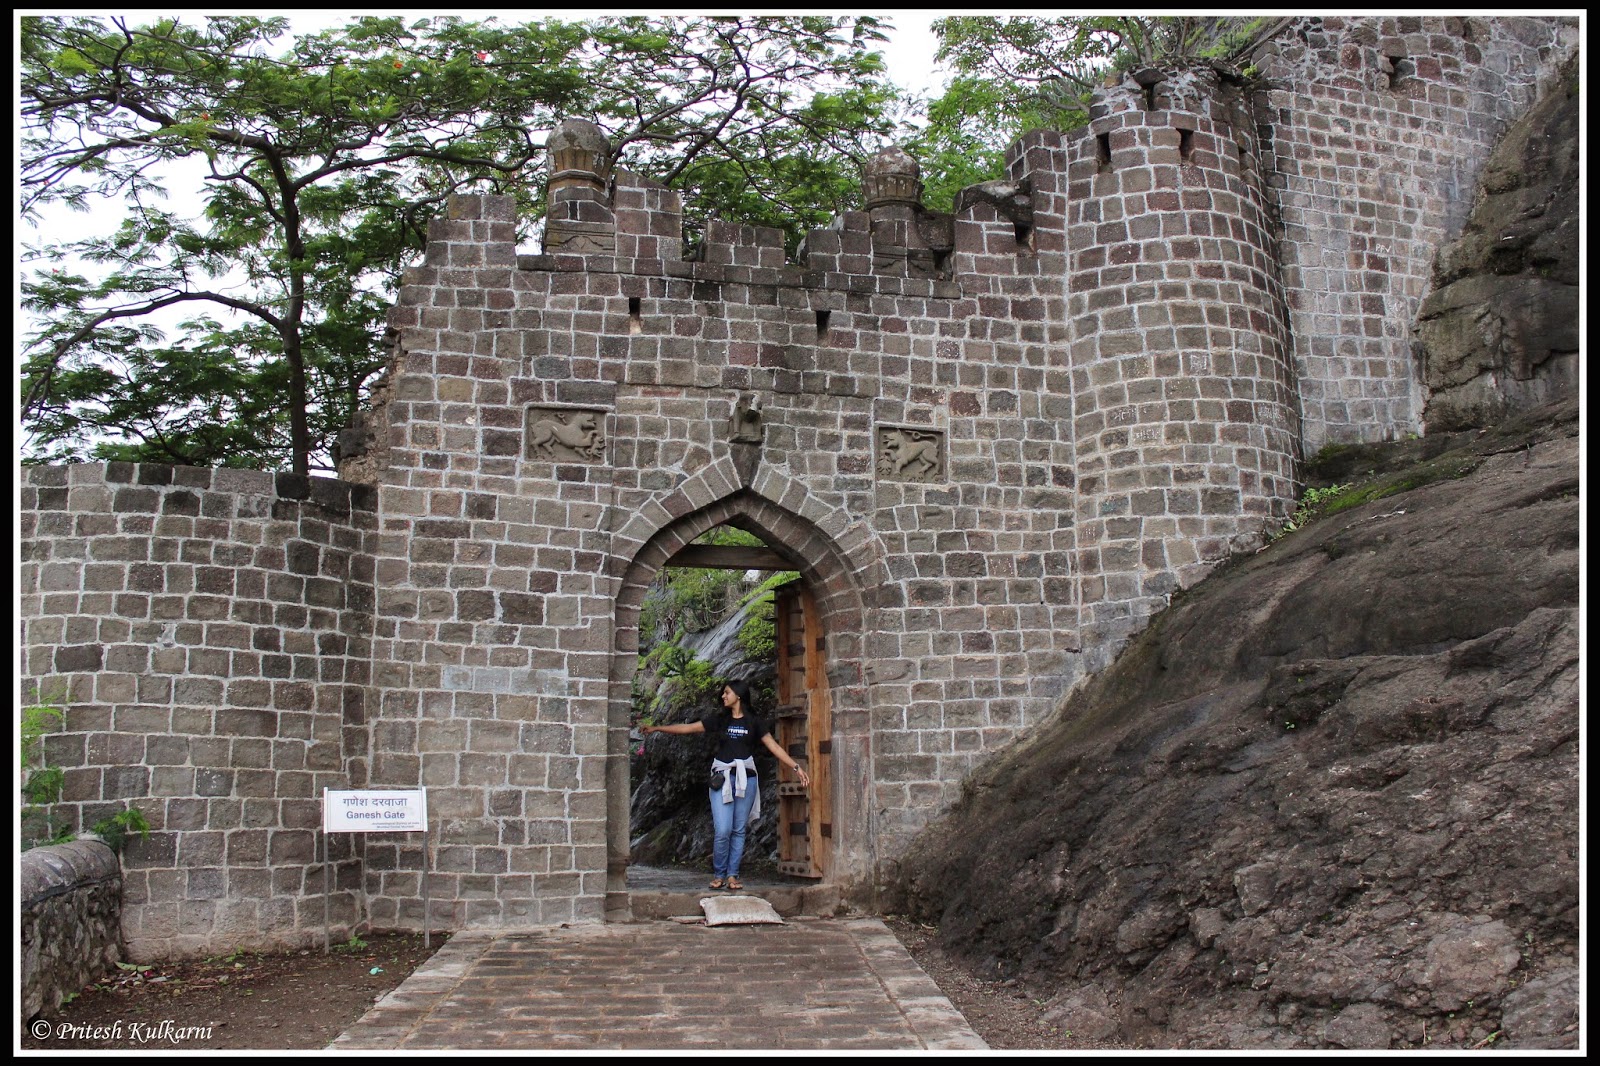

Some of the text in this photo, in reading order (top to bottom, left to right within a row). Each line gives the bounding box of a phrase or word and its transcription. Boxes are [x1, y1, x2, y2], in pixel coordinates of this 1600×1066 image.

[342, 795, 408, 807] गणेश दरवाजा
[346, 810, 406, 819] Ganesh Gate
